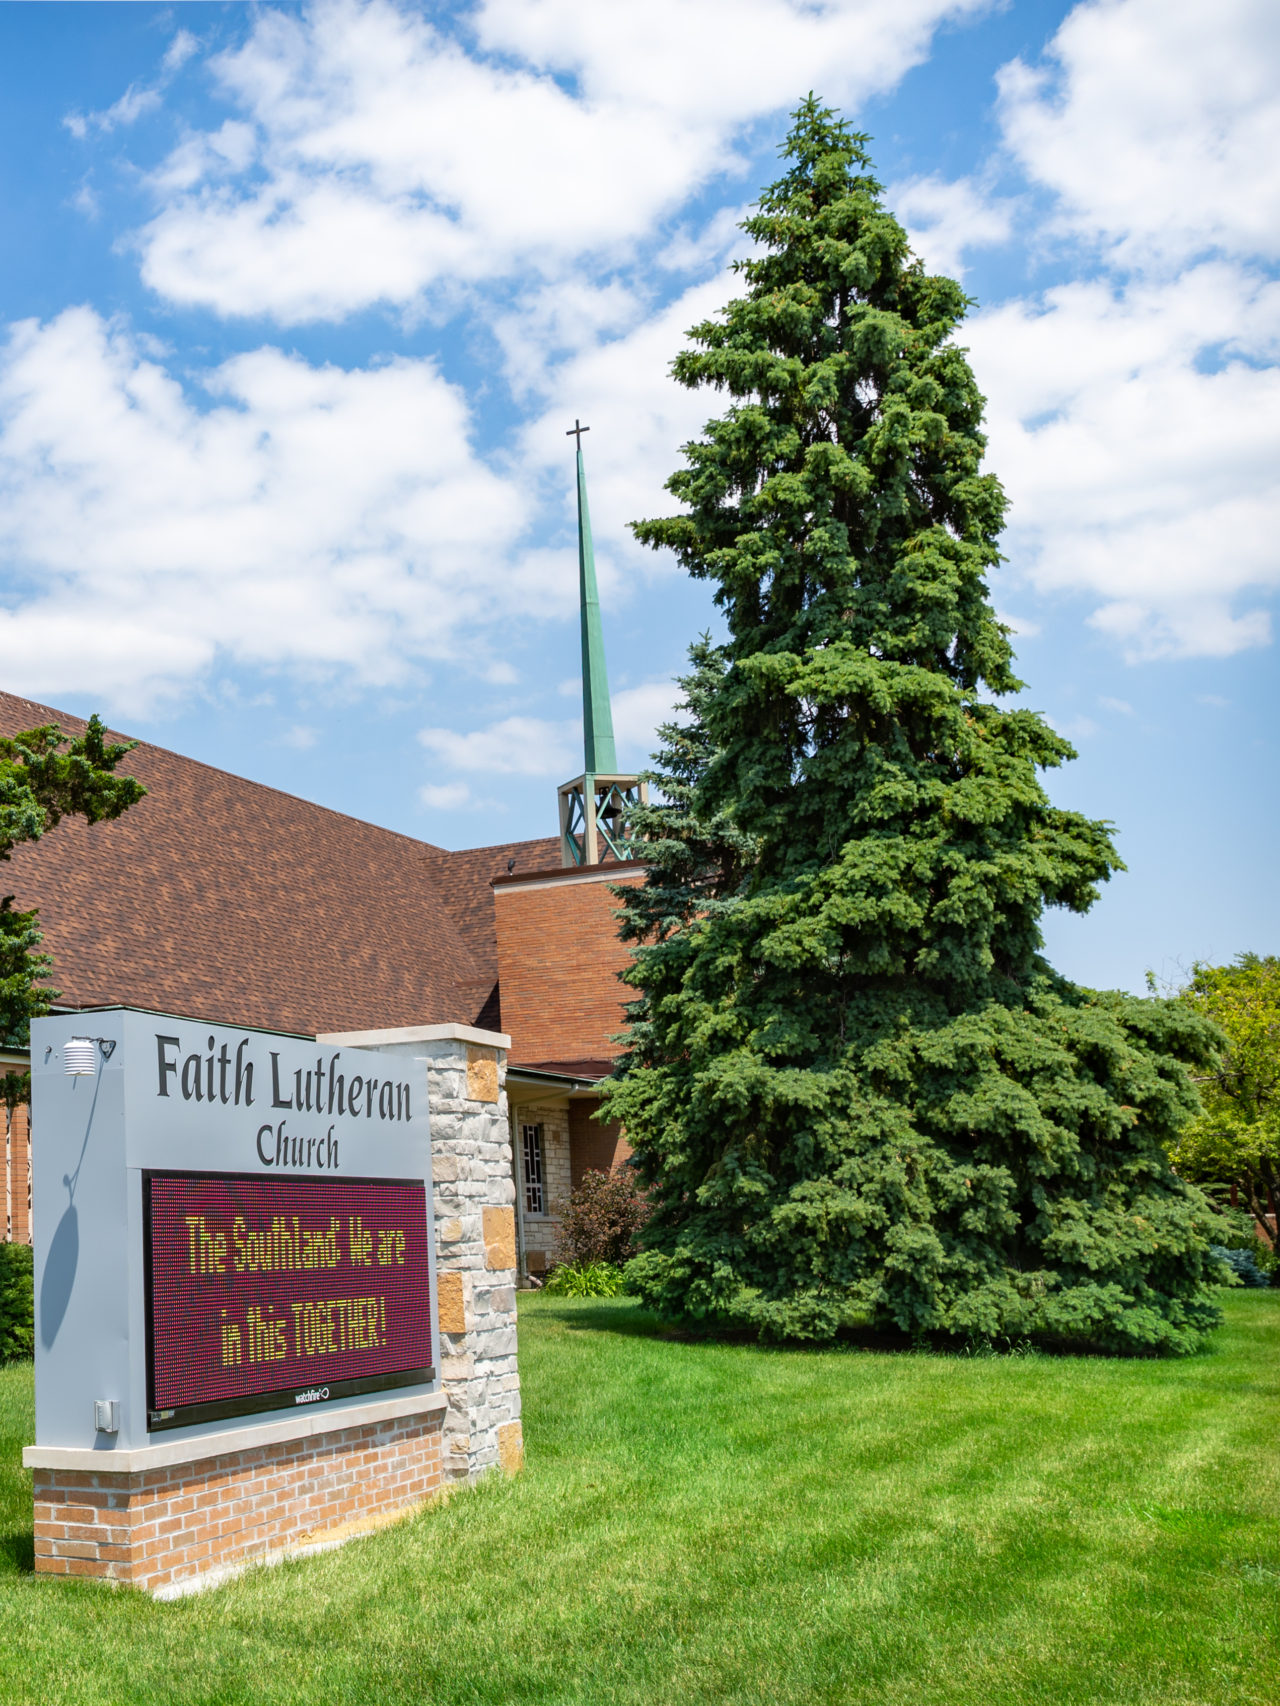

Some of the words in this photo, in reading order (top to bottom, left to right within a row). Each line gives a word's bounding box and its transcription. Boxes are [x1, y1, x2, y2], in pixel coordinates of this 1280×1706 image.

[154, 1033, 256, 1107] Faith
[269, 1052, 413, 1122] Lutheran
[256, 1119, 340, 1169] Church
[185, 1216, 227, 1274] The
[349, 1216, 373, 1267] We
[377, 1230, 406, 1265] are
[221, 1309, 242, 1366] in
[246, 1305, 287, 1363] this
[291, 1296, 387, 1357] TOGETHER!
